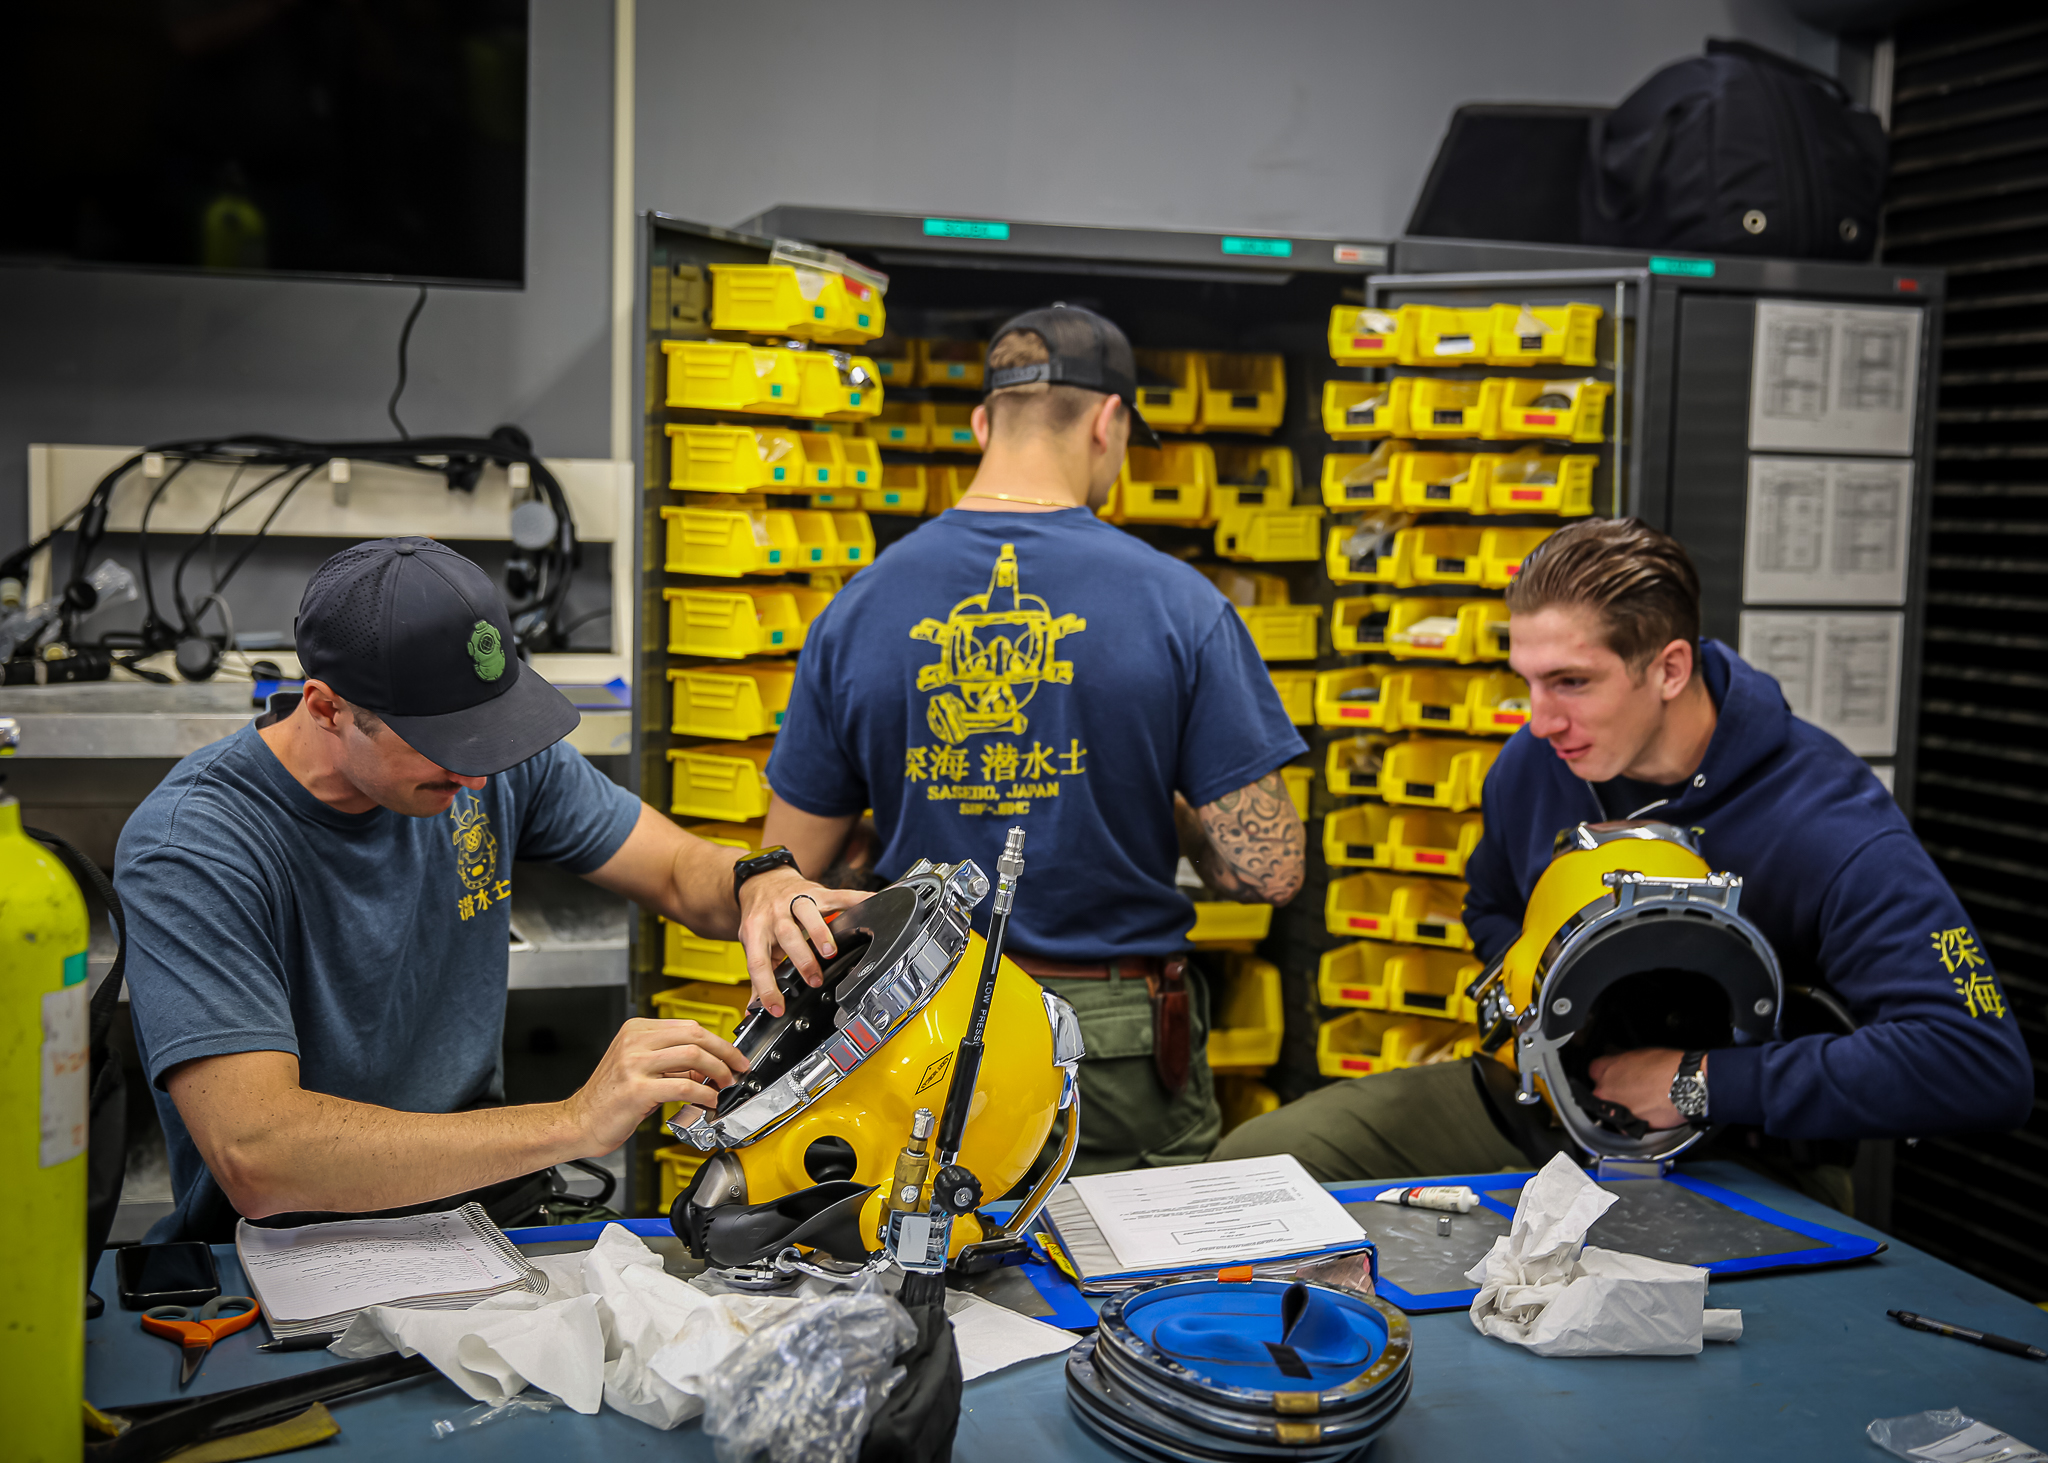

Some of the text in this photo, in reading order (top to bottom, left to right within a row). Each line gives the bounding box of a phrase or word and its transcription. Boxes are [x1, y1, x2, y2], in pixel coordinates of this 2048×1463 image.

[1005, 782, 1060, 799] JAPAN
[1930, 926, 2007, 1019] 深海
[983, 981, 994, 1004] LOW
